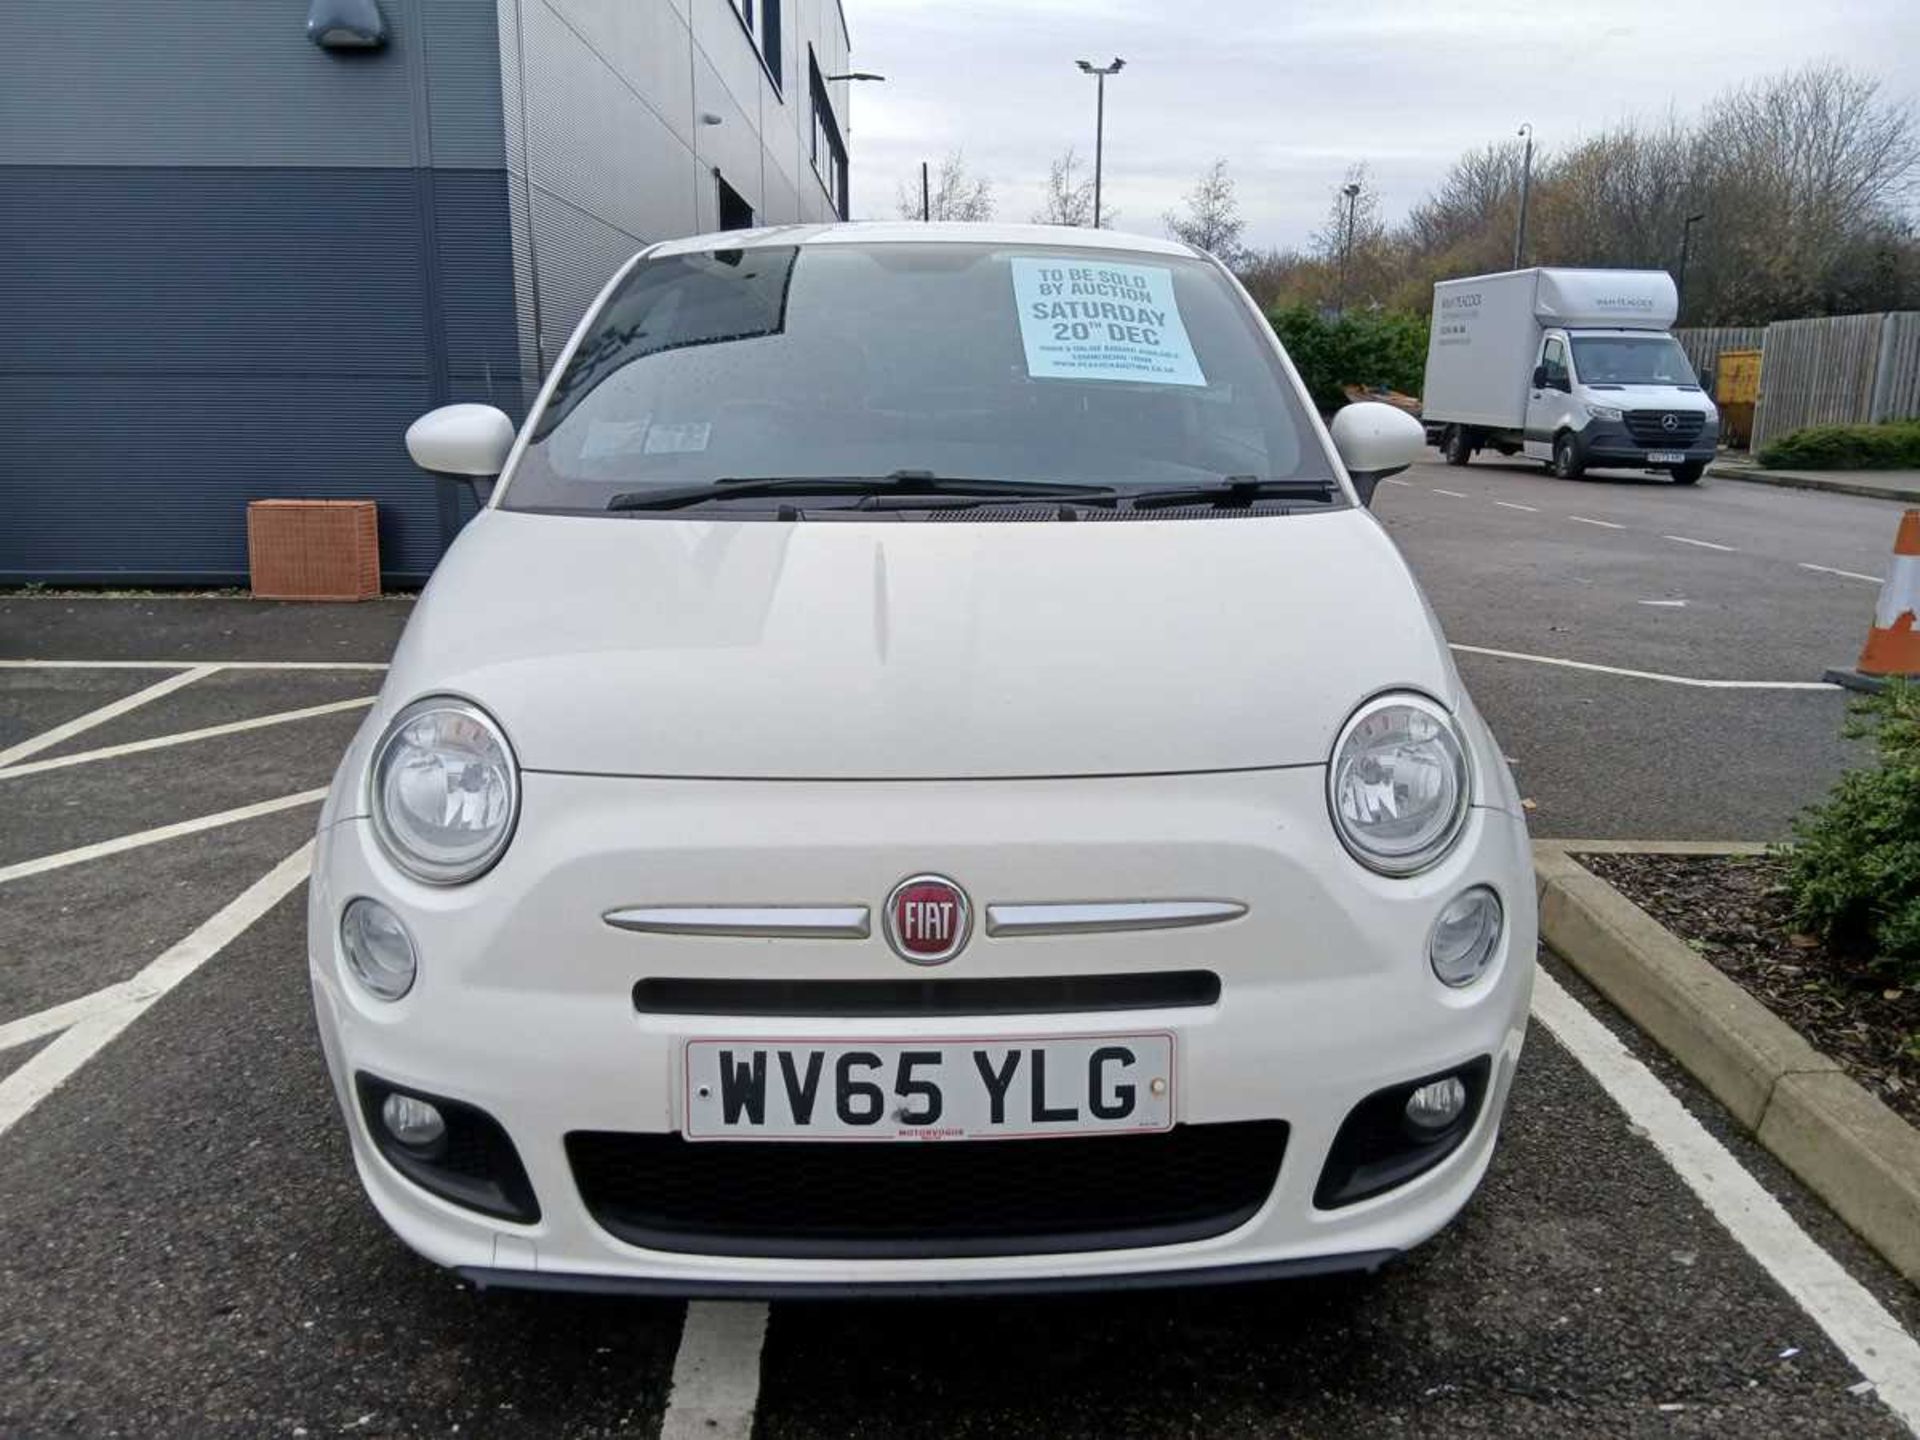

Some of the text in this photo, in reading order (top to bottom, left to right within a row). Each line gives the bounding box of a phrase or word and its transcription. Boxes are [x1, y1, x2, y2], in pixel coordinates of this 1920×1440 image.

[1038, 268, 1147, 289] TO BE SOLD
[1039, 283, 1152, 303] BY AUCTION
[1032, 301, 1165, 327] SATURDAY
[1108, 323, 1160, 346] DEC
[905, 902, 953, 939] FIAT
[719, 1046, 1136, 1126] WV65 YLG
